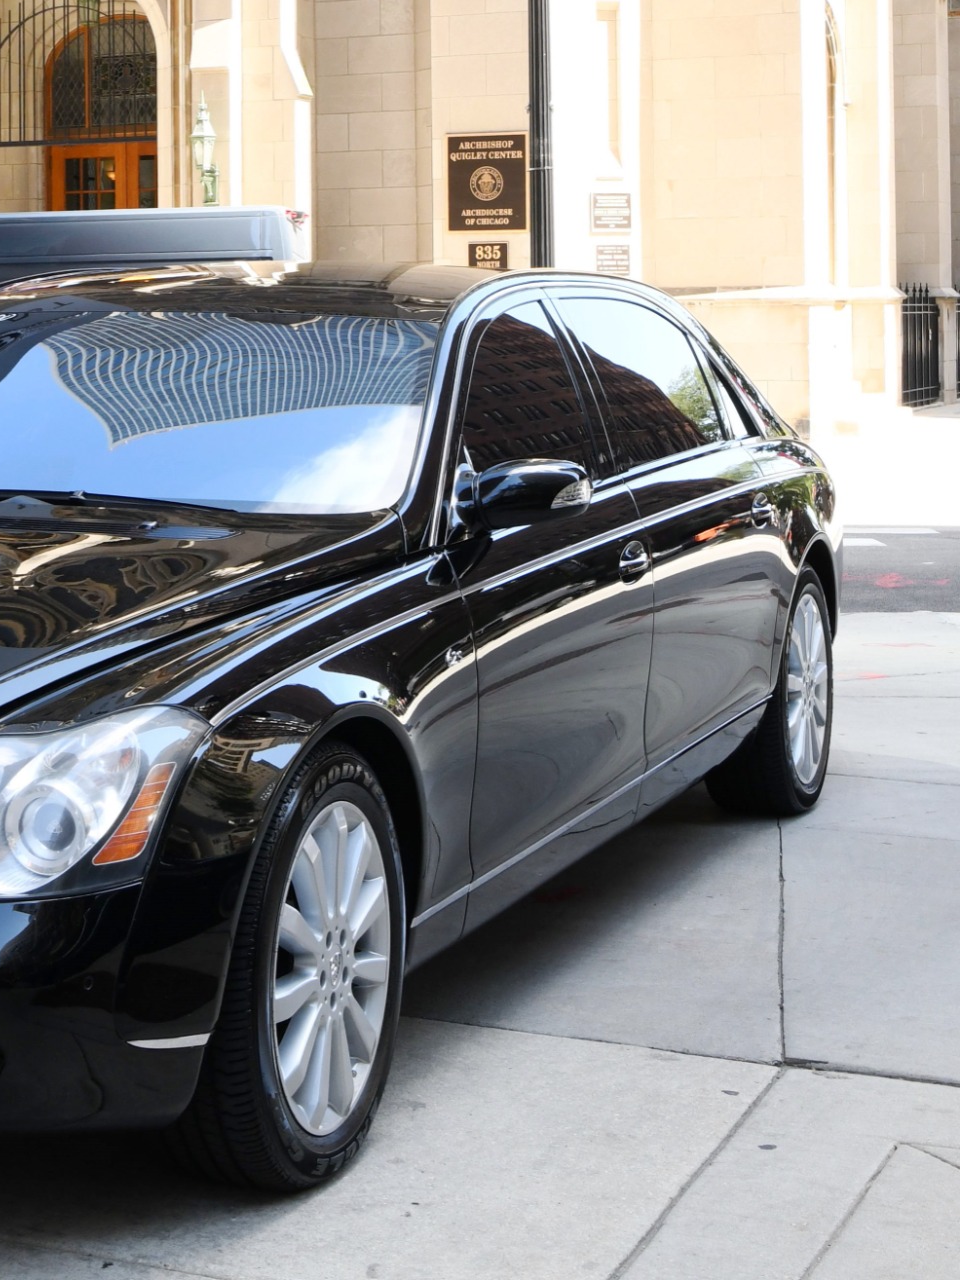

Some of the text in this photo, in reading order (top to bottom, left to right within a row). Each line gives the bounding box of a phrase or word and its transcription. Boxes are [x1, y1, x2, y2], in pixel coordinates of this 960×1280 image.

[458, 140, 514, 150] ARCHBISHOP
[449, 150, 523, 162] QUIGLEY CENTER
[461, 208, 513, 217] ARCHDIOCESE
[465, 217, 509, 226] OF CHICAGO
[475, 245, 501, 260] 835
[476, 260, 500, 269] NORTH
